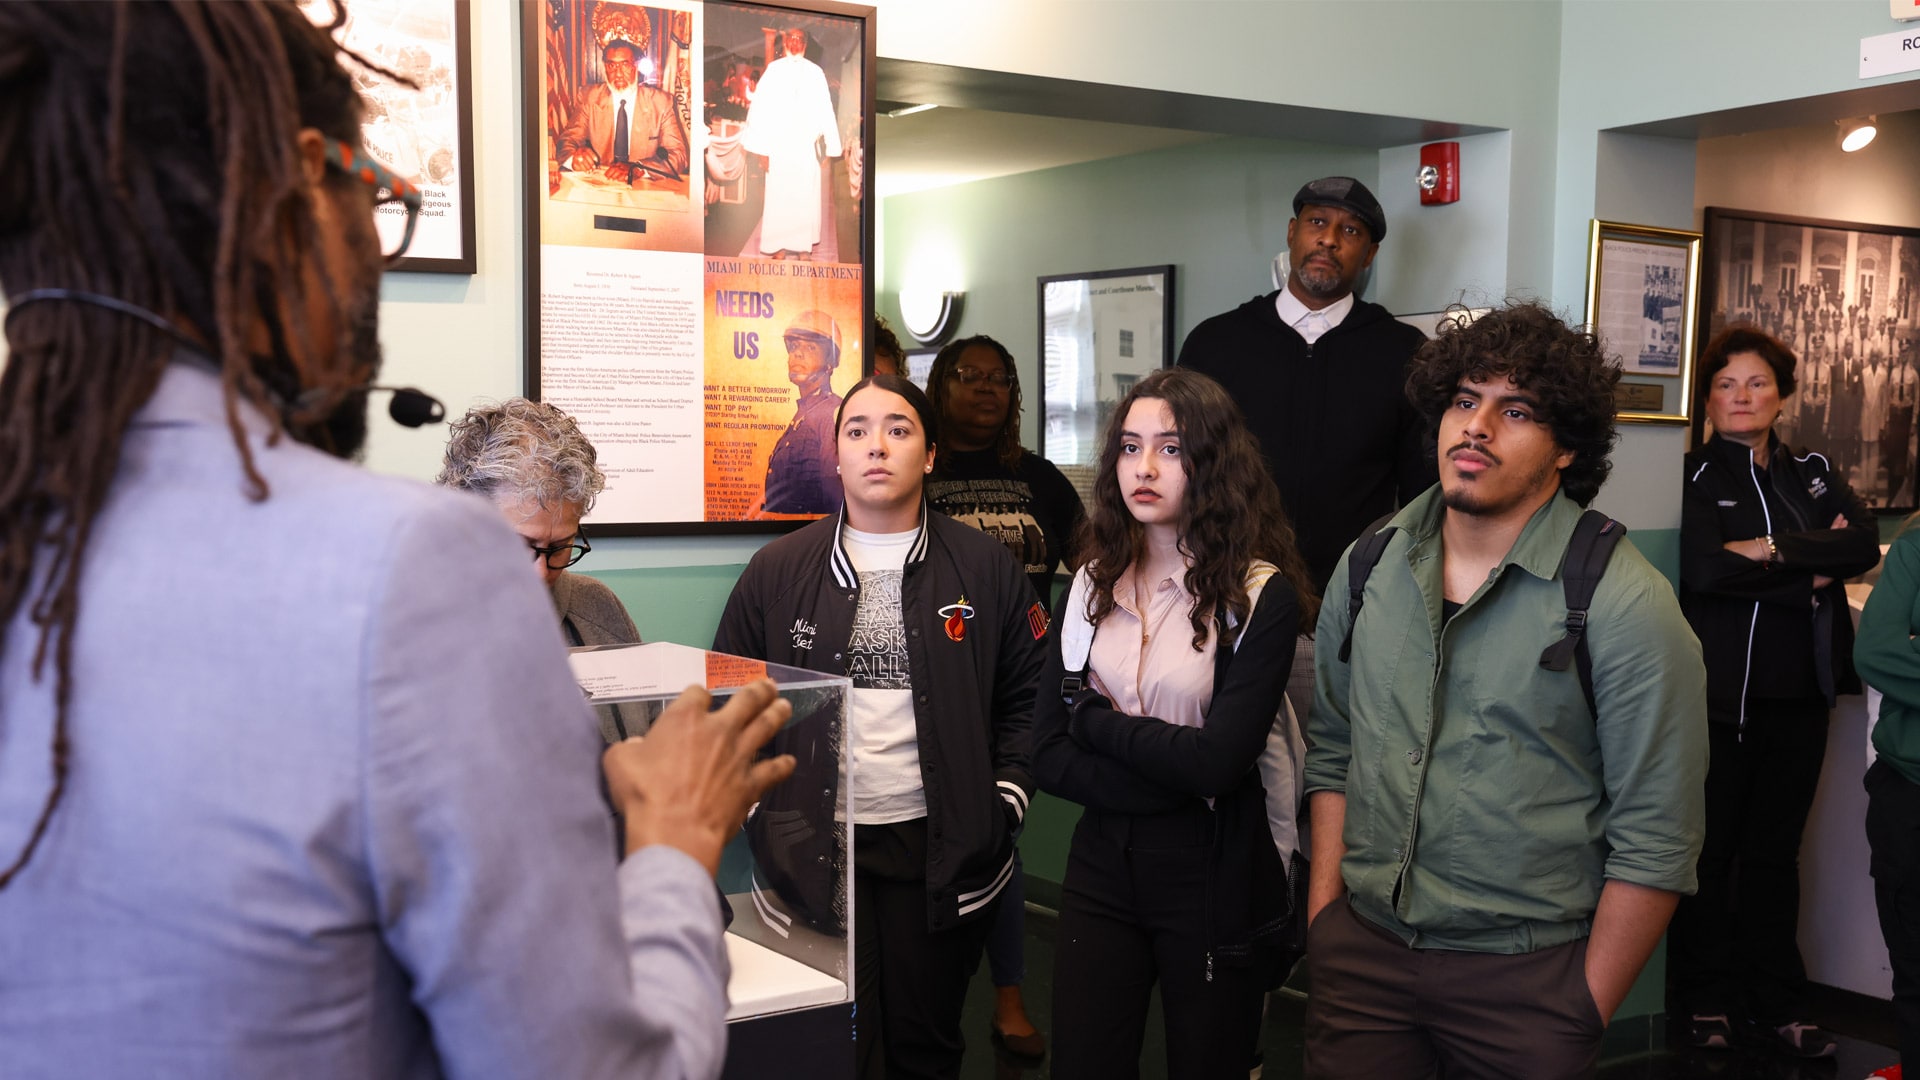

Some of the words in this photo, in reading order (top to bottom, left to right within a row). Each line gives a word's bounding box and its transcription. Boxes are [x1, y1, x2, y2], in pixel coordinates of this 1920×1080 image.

[424, 190, 446, 198] Black
[376, 206, 408, 216] Motorcyc
[418, 208, 446, 217] Squad.
[422, 200, 452, 208] tigeous
[706, 261, 742, 274] MIAMI
[749, 263, 786, 276] POLICE
[792, 265, 861, 280] DEPARTMENT
[715, 289, 774, 318] NEEDS
[733, 331, 759, 359] US
